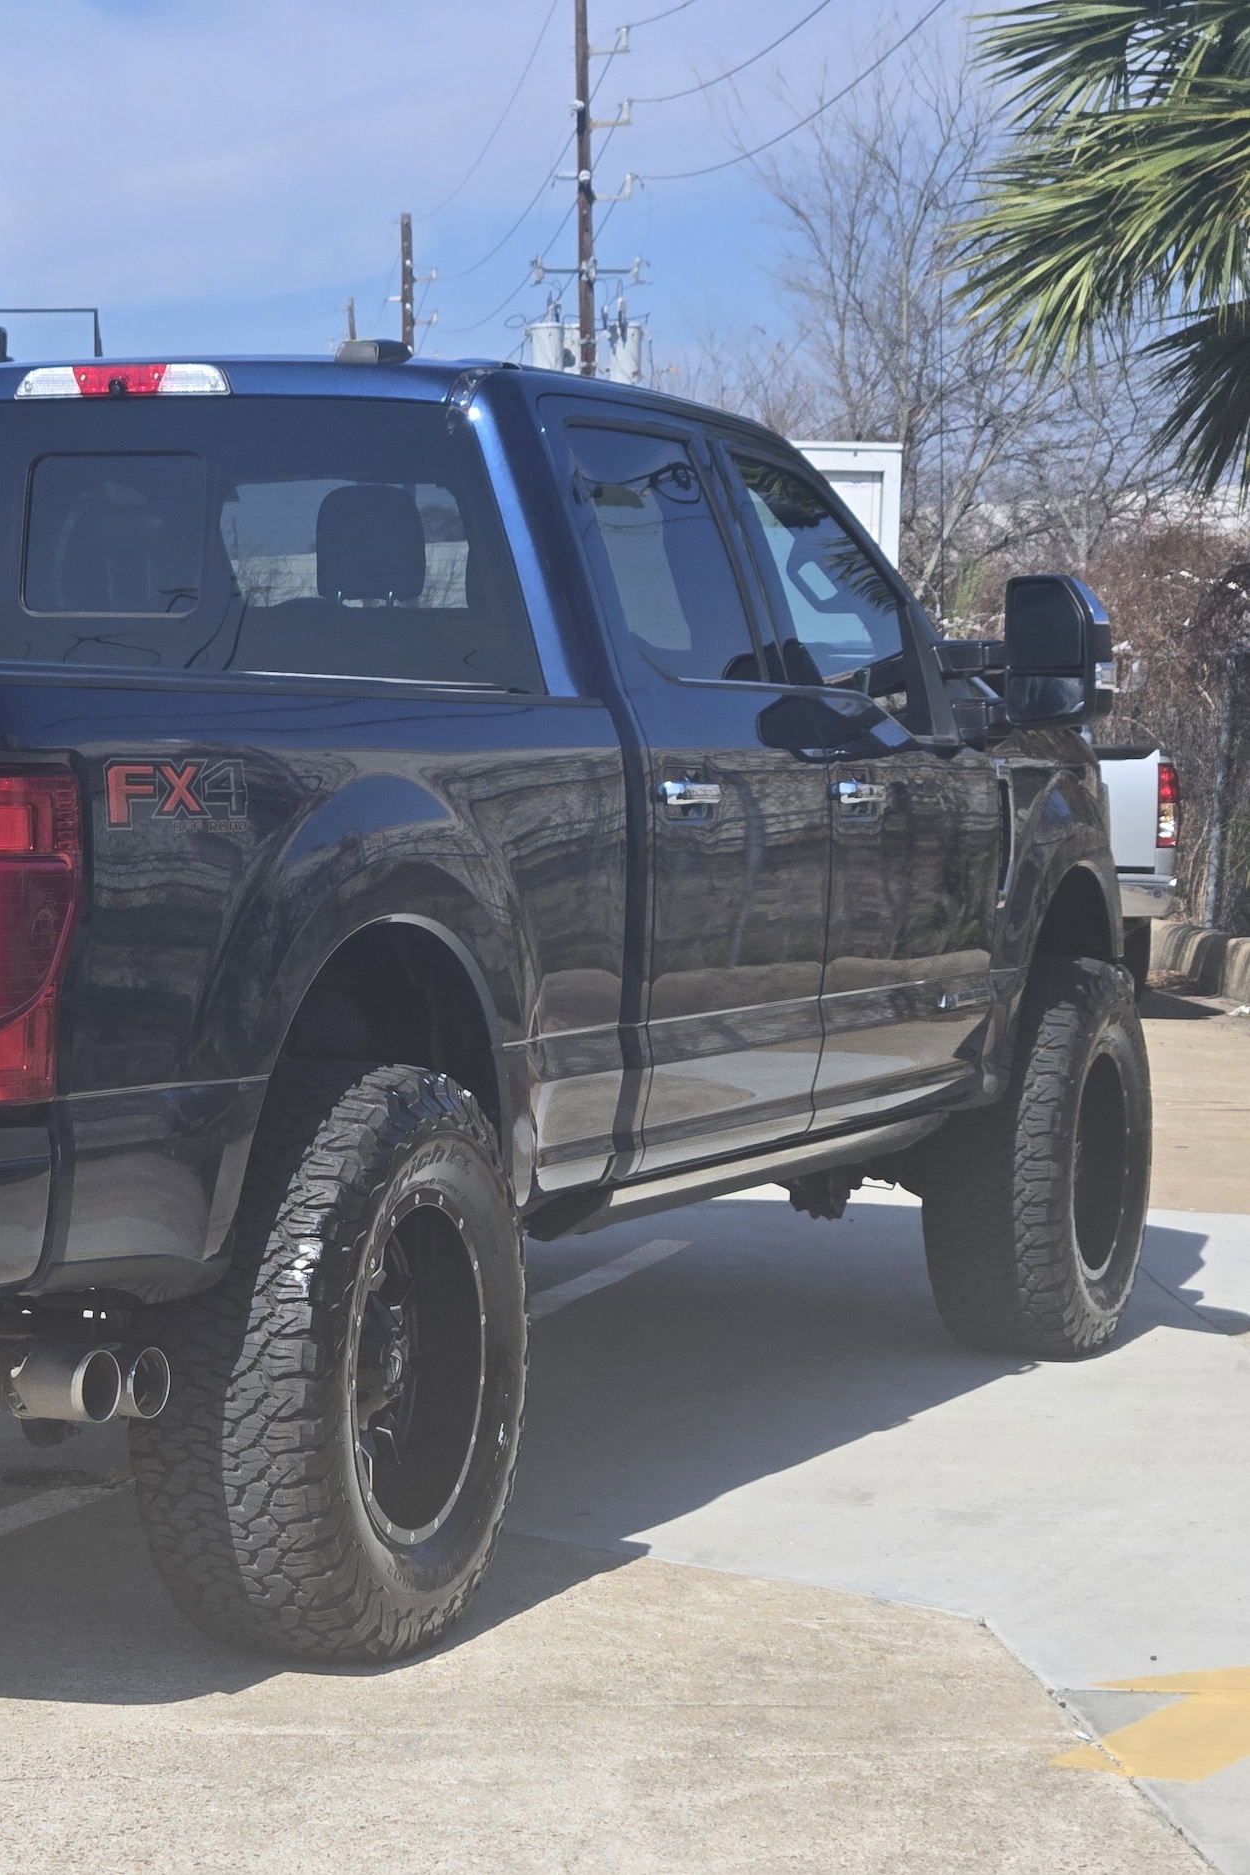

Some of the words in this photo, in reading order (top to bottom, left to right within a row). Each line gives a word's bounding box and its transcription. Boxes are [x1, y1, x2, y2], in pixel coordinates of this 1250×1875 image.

[103, 758, 248, 830] FX4
[172, 819, 203, 833] OFF
[207, 819, 249, 833] ROAD
